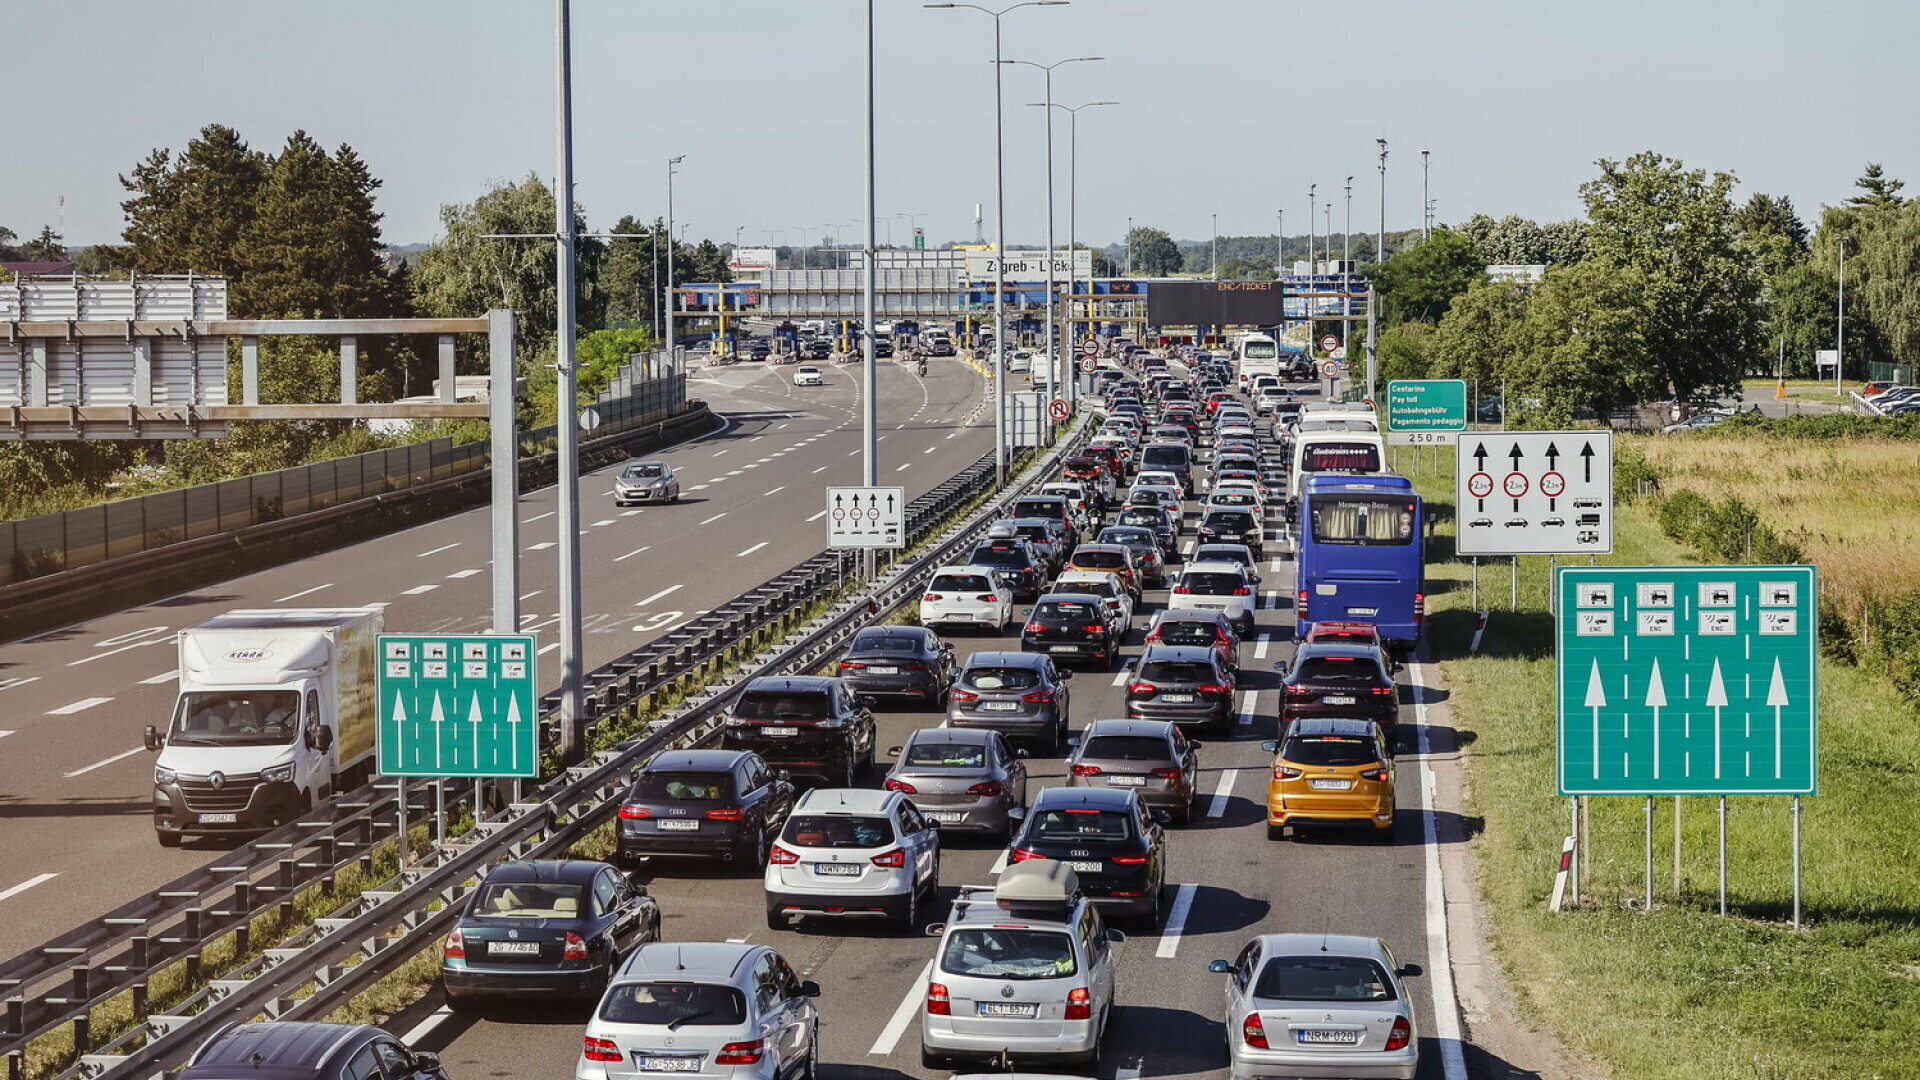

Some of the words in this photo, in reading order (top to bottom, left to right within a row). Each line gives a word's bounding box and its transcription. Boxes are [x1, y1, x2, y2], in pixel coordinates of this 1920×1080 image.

[1084, 360, 1094, 369] 40
[1326, 365, 1336, 373] 40
[1392, 396, 1405, 404] Pay
[1392, 407, 1447, 415] Autobahngebühr
[1392, 418, 1431, 426] Pagamento
[1432, 418, 1463, 426] pedaggio
[1409, 433, 1432, 442] 250
[1307, 1031, 1353, 1041] NRM-020
